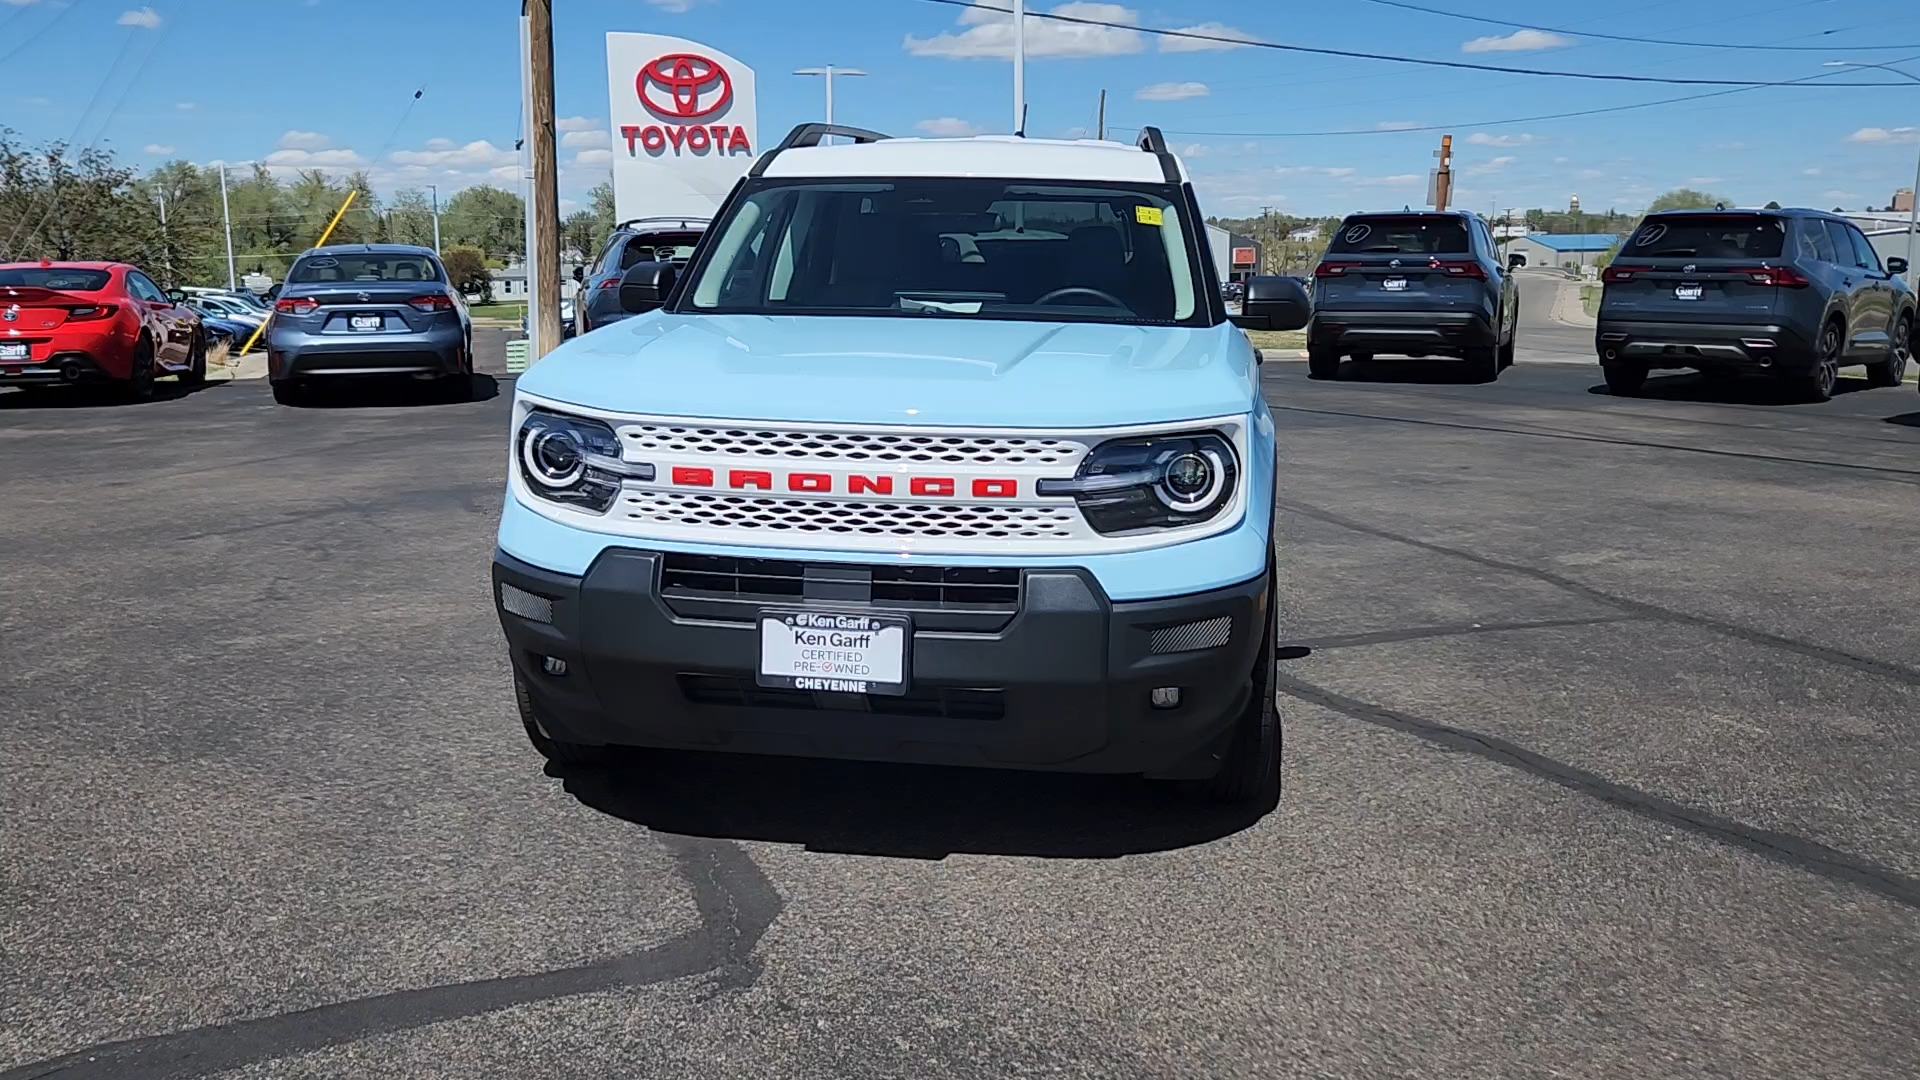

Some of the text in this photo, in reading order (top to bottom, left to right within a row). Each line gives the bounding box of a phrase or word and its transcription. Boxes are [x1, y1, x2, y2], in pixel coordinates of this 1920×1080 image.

[621, 125, 751, 154] TOYOTA
[351, 316, 381, 328] Garff
[671, 466, 1018, 498] BRONCO
[808, 614, 870, 630] Ken Garff
[795, 631, 870, 648] Ken Garff
[802, 649, 862, 662] CERTIFIED
[795, 678, 866, 692] CHEYENNE
